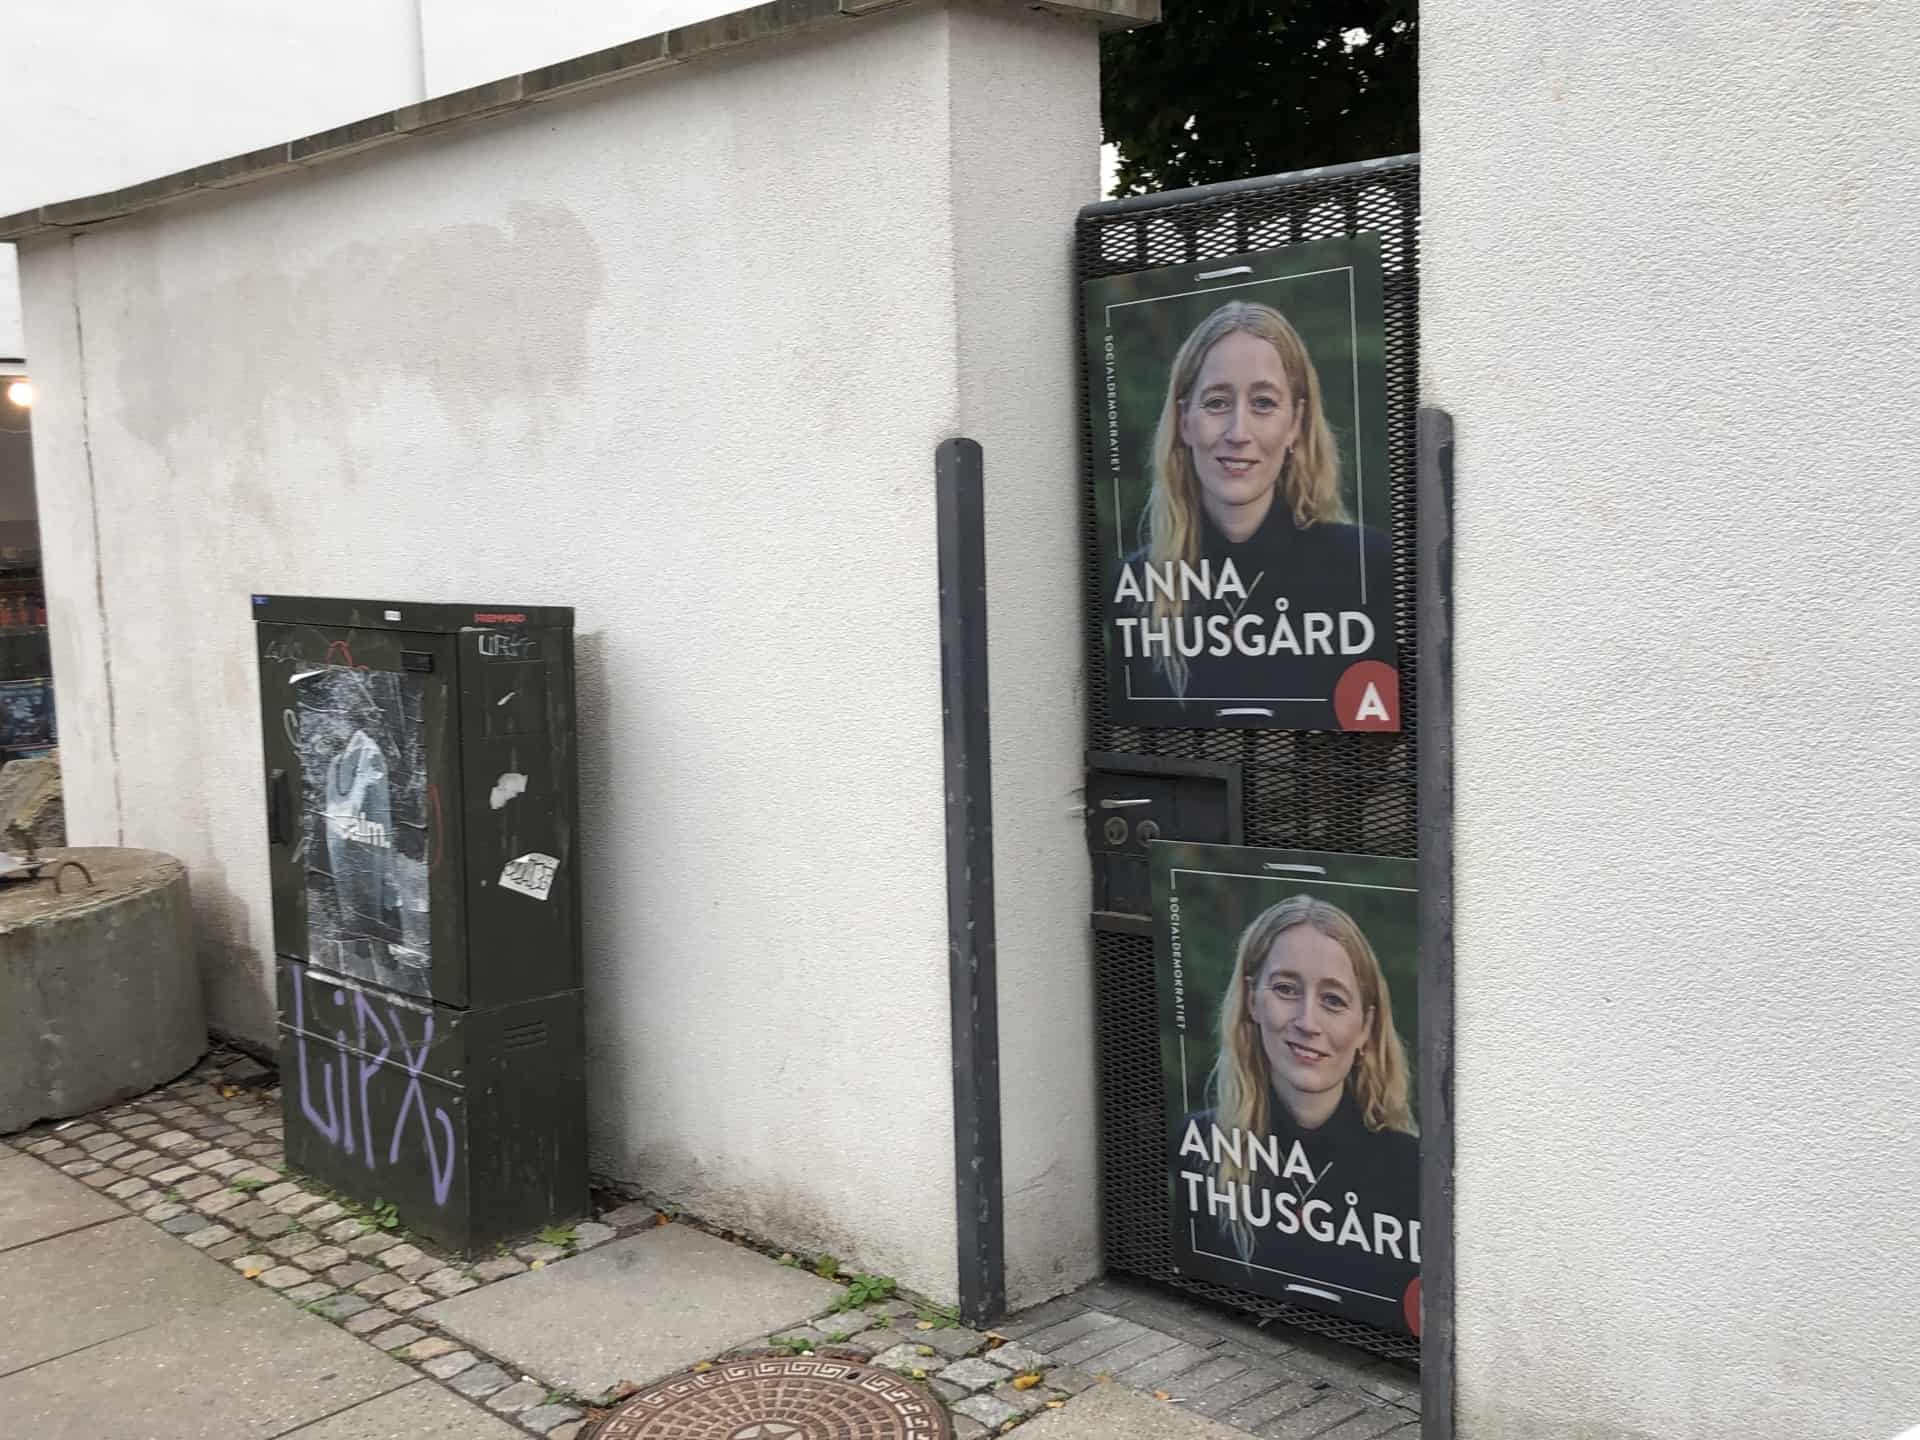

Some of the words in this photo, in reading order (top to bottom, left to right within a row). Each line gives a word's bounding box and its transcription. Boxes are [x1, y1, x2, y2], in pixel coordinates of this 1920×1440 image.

[1104, 335, 1120, 471] SOCIALDEMOKRATIET
[1113, 557, 1249, 603] ANNA
[1114, 597, 1376, 658] THUSGÅRD
[1355, 682, 1391, 721] A
[1169, 896, 1186, 1029] SOCIALDEMOKRATIET
[1179, 1119, 1317, 1184] ANNA
